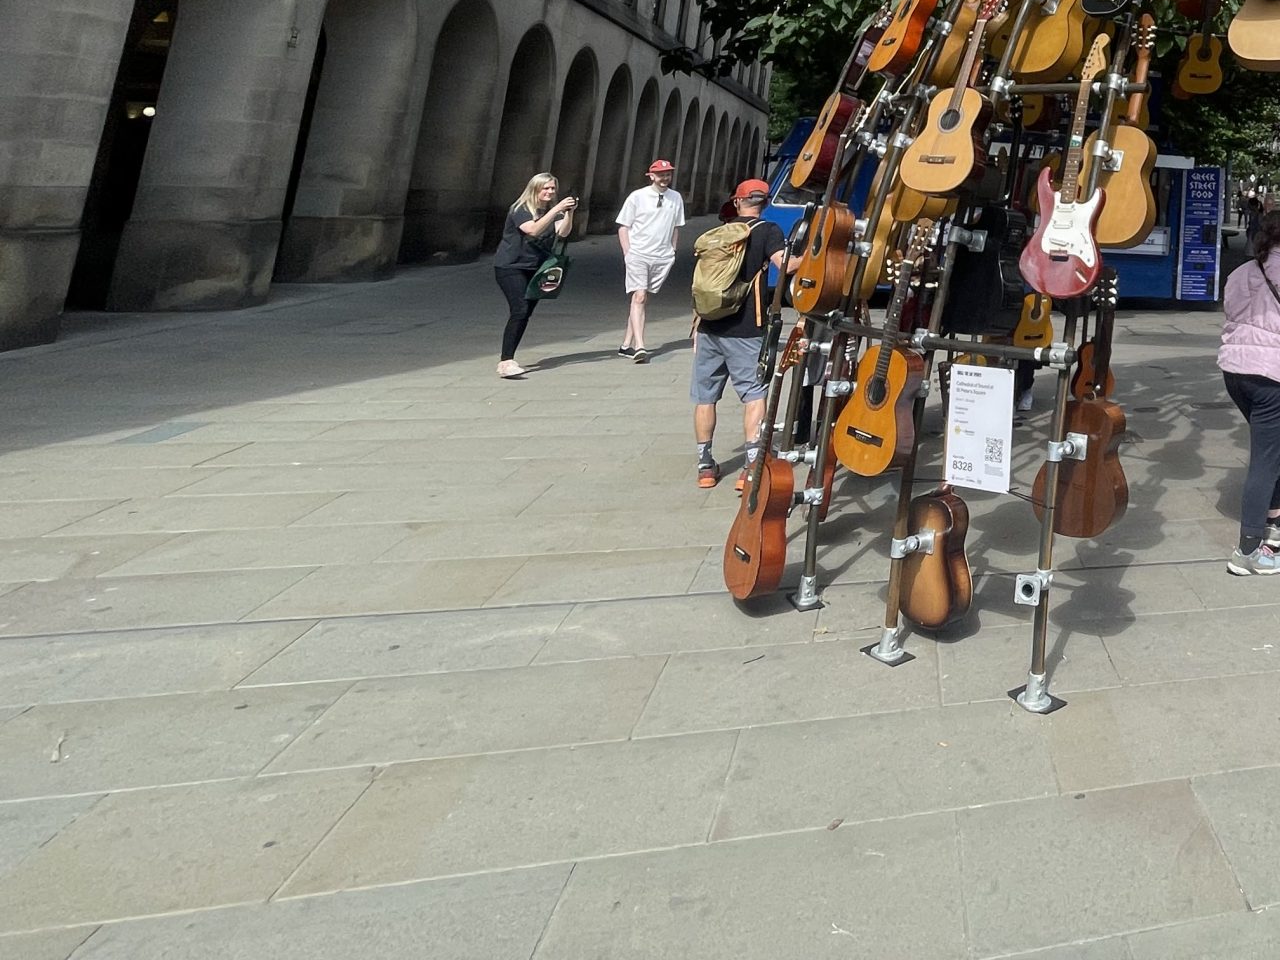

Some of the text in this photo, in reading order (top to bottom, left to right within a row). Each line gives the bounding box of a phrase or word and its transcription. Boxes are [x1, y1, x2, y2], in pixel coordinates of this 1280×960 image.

[1190, 181, 1217, 190] STREET
[1191, 190, 1214, 199] FOOD
[952, 460, 973, 472] 8328
